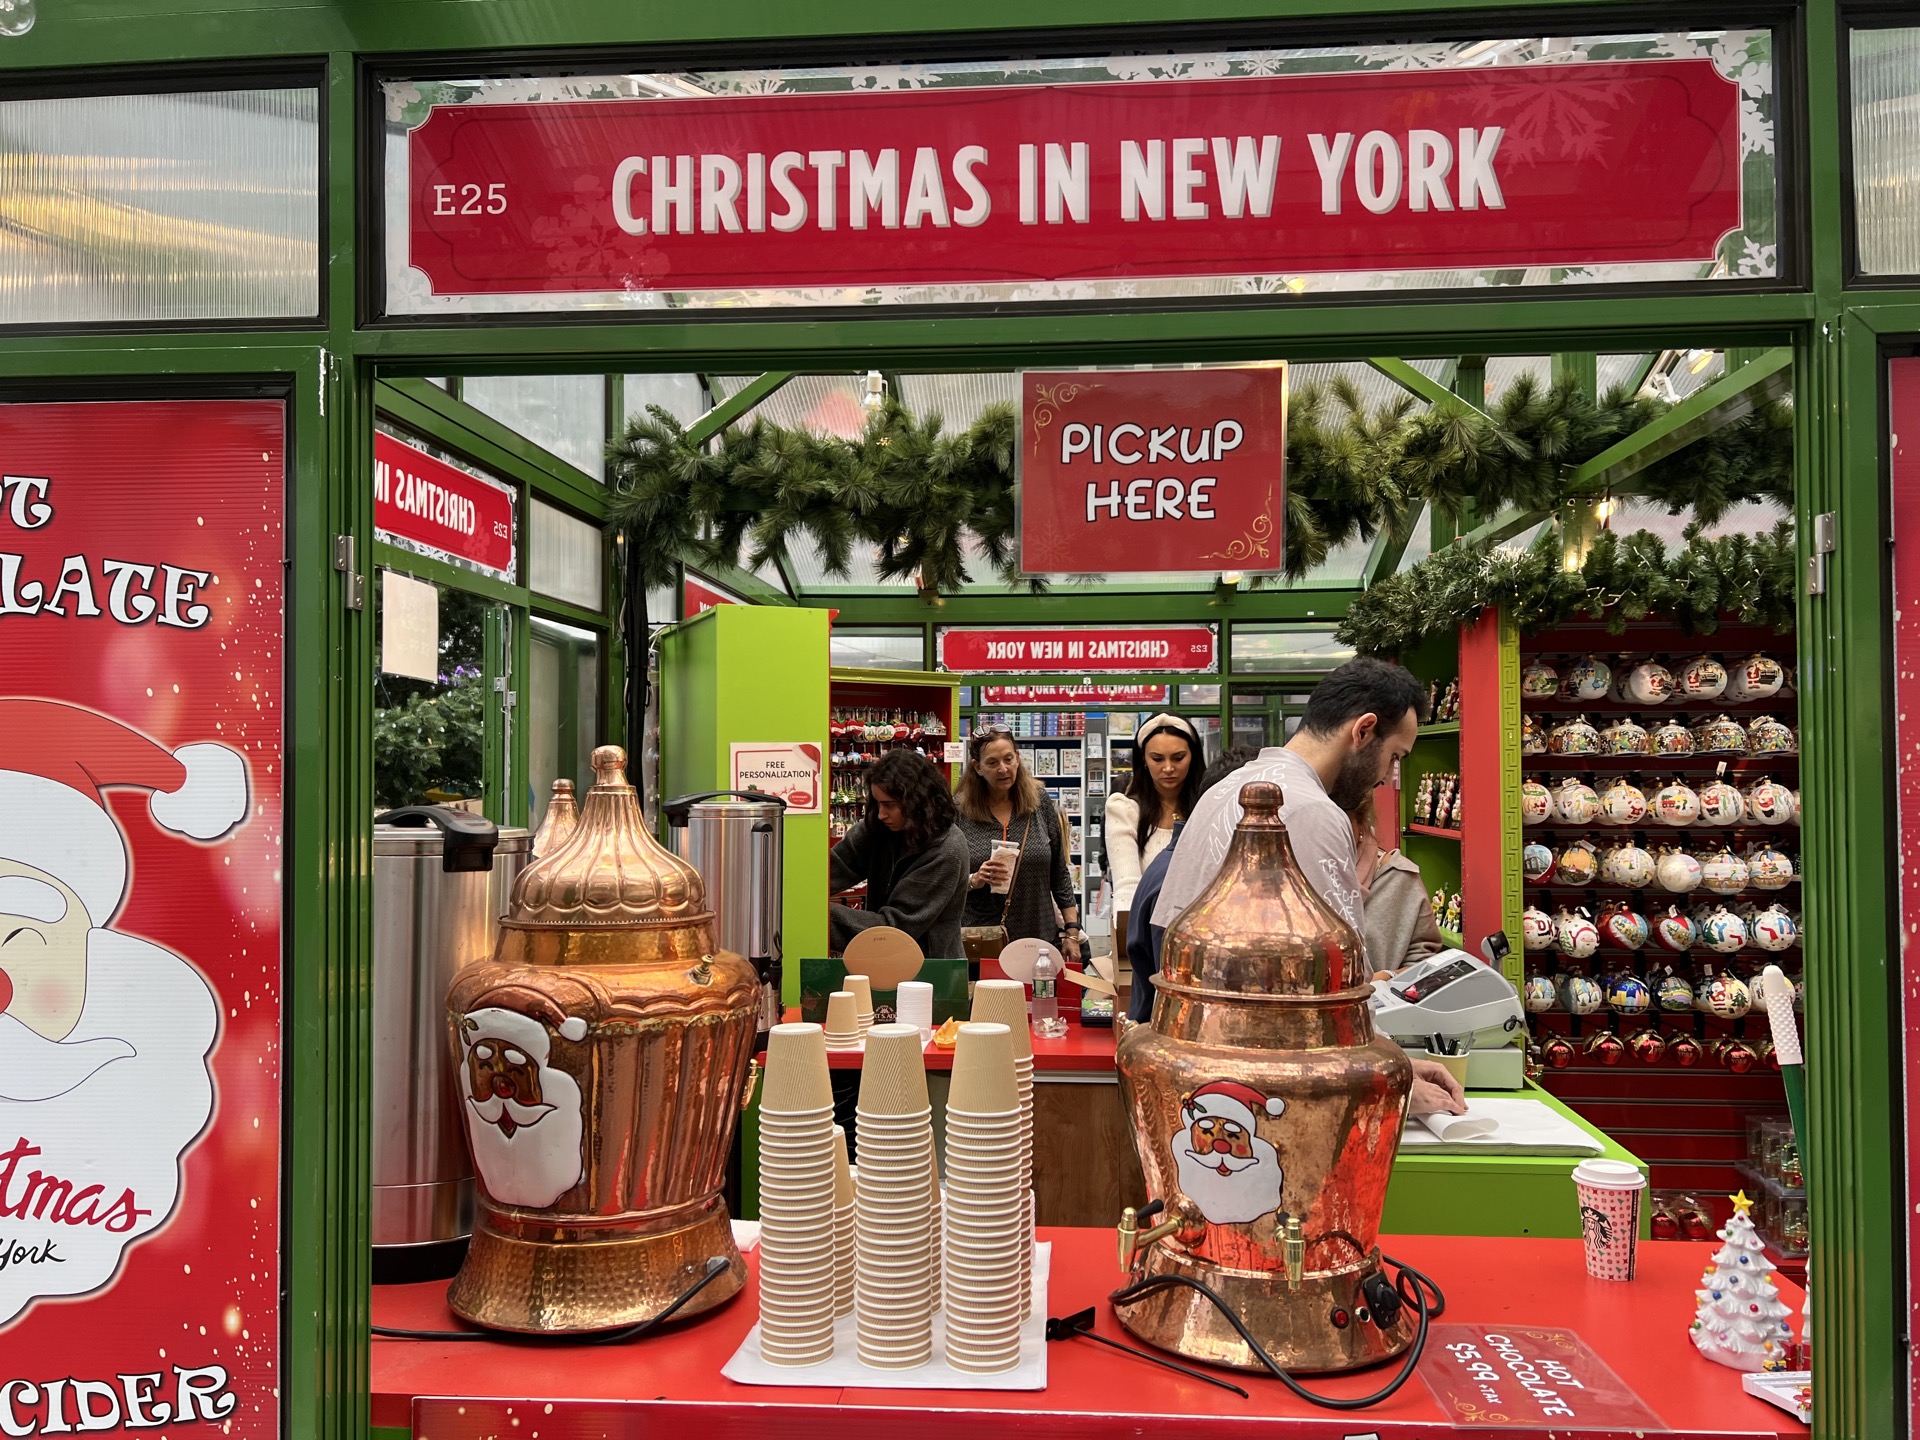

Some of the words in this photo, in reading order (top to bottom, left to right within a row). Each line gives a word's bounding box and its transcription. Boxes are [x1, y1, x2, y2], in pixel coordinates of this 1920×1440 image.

[433, 183, 507, 216] E25
[612, 145, 991, 235] CHRISTMAS
[1019, 142, 1090, 225] IN
[1121, 135, 1282, 220] NEW
[1308, 126, 1506, 215] YORK
[1061, 419, 1244, 464] PICKUP
[0, 475, 53, 529] T
[1086, 477, 1218, 522] HERE
[1004, 685, 1026, 694] NEW
[739, 770, 811, 778] PERSONALIZATION
[1445, 1342, 1500, 1381] $5.99
[1484, 1334, 1576, 1418] CHOCOLATE
[1535, 1359, 1584, 1389] HOT
[0, 1364, 236, 1436] CIDER
